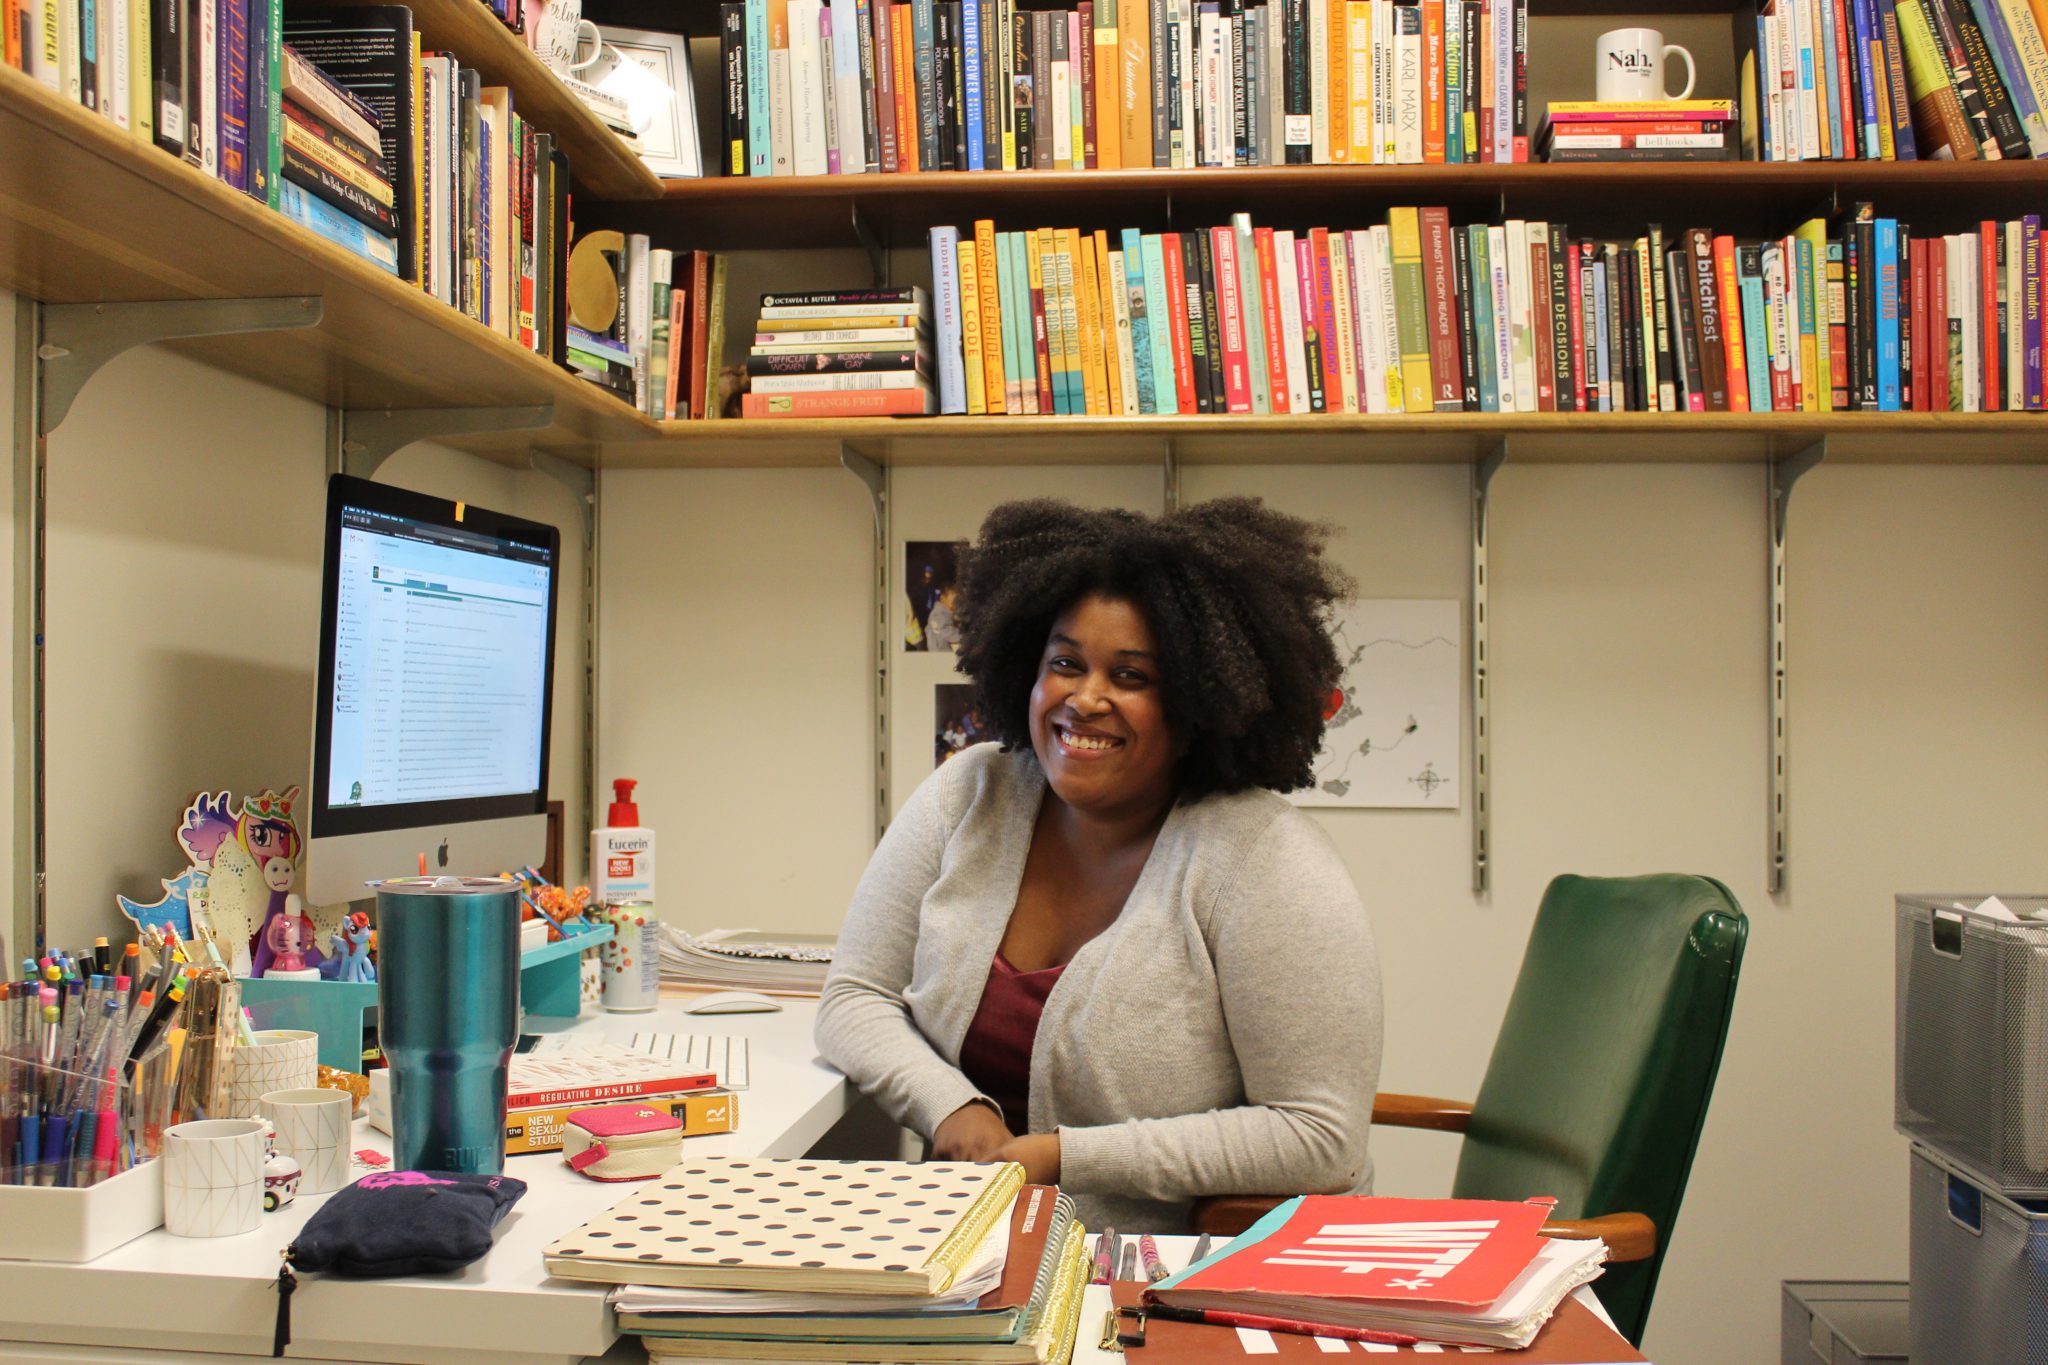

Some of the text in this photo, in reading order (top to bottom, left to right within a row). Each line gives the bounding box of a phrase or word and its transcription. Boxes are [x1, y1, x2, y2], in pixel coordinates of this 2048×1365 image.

[45, 2, 57, 62] COOPER
[1016, 16, 1029, 72] Orientalism
[1056, 19, 1064, 50] Foucault
[1233, 15, 1243, 27] THE
[1515, 8, 1526, 52] Illuminating
[1921, 2, 1939, 33] Writing
[2021, 10, 2043, 56] Statistical
[774, 52, 782, 95] Approaches
[964, 3, 978, 94] CULTURE POWER
[1124, 40, 1146, 110] Distinction
[1171, 51, 1179, 77] Society
[1233, 29, 1244, 76] CONSTRUCTION
[1332, 0, 1345, 140] CULTURAL SCIENCES
[1402, 48, 1415, 85] KARL
[1446, 32, 1460, 86] Selections
[1499, 6, 1508, 132] SOCIOLOGICAL THEORY CLASSICAL ERA
[1608, 49, 1653, 70] Nah.
[1884, 15, 1907, 123] PARTICIPANT OBSERVATION
[1916, 19, 1944, 83] Craft Research
[1959, 23, 1996, 108] SOCIAL RESEARCH
[1969, 26, 2004, 100] APPROACHES TO
[2020, 36, 2047, 110] Social Sciences
[729, 81, 737, 114] Movements
[920, 40, 933, 141] THE PEOPLE'S LOBBY
[1155, 45, 1164, 108] SYMBOLIC POWER
[1234, 78, 1244, 86] OF
[1235, 88, 1245, 110] SOCIAL
[1351, 18, 1368, 147] PRISON NOTEBOOKS GRAMSCI
[1861, 36, 1874, 117] Successful scientific writing
[1235, 112, 1245, 137] REALITY
[1402, 89, 1416, 132] MARX
[1645, 137, 1694, 146] bell hooks
[345, 184, 377, 215] Called Back
[940, 237, 952, 326] HIDDEN FIGURES
[1150, 258, 1163, 316] UNBOUND
[1300, 243, 1310, 279] Decolonizing
[1381, 267, 1394, 307] FEMINIST
[1432, 225, 1449, 335] FEMINIST THEORY READER
[1553, 263, 1565, 297] SPLIT
[1641, 249, 1652, 318] TALKING BACK
[1723, 256, 1735, 317] THE FEMINIST
[1801, 242, 1811, 323] HIJAS AMERICANAS
[2026, 224, 2040, 320] The Women Founders
[619, 286, 626, 300] MY
[775, 297, 803, 305] OCTAVIA
[962, 263, 979, 357] GIRL CODE
[978, 228, 999, 363] CRASH OVERRIDE
[1220, 233, 1238, 349] FEMINIST METHODS SOCIAL RESEARCH
[1319, 256, 1337, 375] BEYOND METHODOLOGY
[1697, 260, 1718, 342] bitchfest
[1775, 276, 1786, 355] NO TURNING BACK
[1882, 292, 1897, 320] LIVES
[619, 326, 626, 334] IS
[1045, 309, 1062, 357] BARRIERS
[1062, 307, 1079, 355] BARRIERS
[1088, 301, 1102, 367] WOMEN STEM
[1103, 299, 1116, 364] WOMEN STEM
[1186, 284, 1205, 356] PROMISES CAN KEEP
[1205, 291, 1221, 373] POLITICS OF PIETY
[1265, 279, 1280, 374] FEMINIST RESEARCH PRACTICE
[1336, 269, 1352, 375] FEMINIST EPISTEMOLOGIES
[1362, 290, 1378, 370] Living Feminist Life
[1495, 266, 1509, 380] EMERGING INTERSECTIONS
[1555, 304, 1569, 379] DECISIONS
[1730, 319, 1742, 370] PORN BOOK
[768, 354, 810, 363] DIFFICULT
[770, 361, 863, 371] WOMEN GAY
[1039, 354, 1048, 392] TECHNOLOGY
[796, 396, 887, 409] STRANGE FRUIT
[608, 839, 648, 850] Eucerin
[528, 1115, 554, 1127] NEW
[539, 1084, 642, 1104] REGULATING DESIRE
[508, 1127, 522, 1136] the
[528, 1126, 564, 1137] SEXUA
